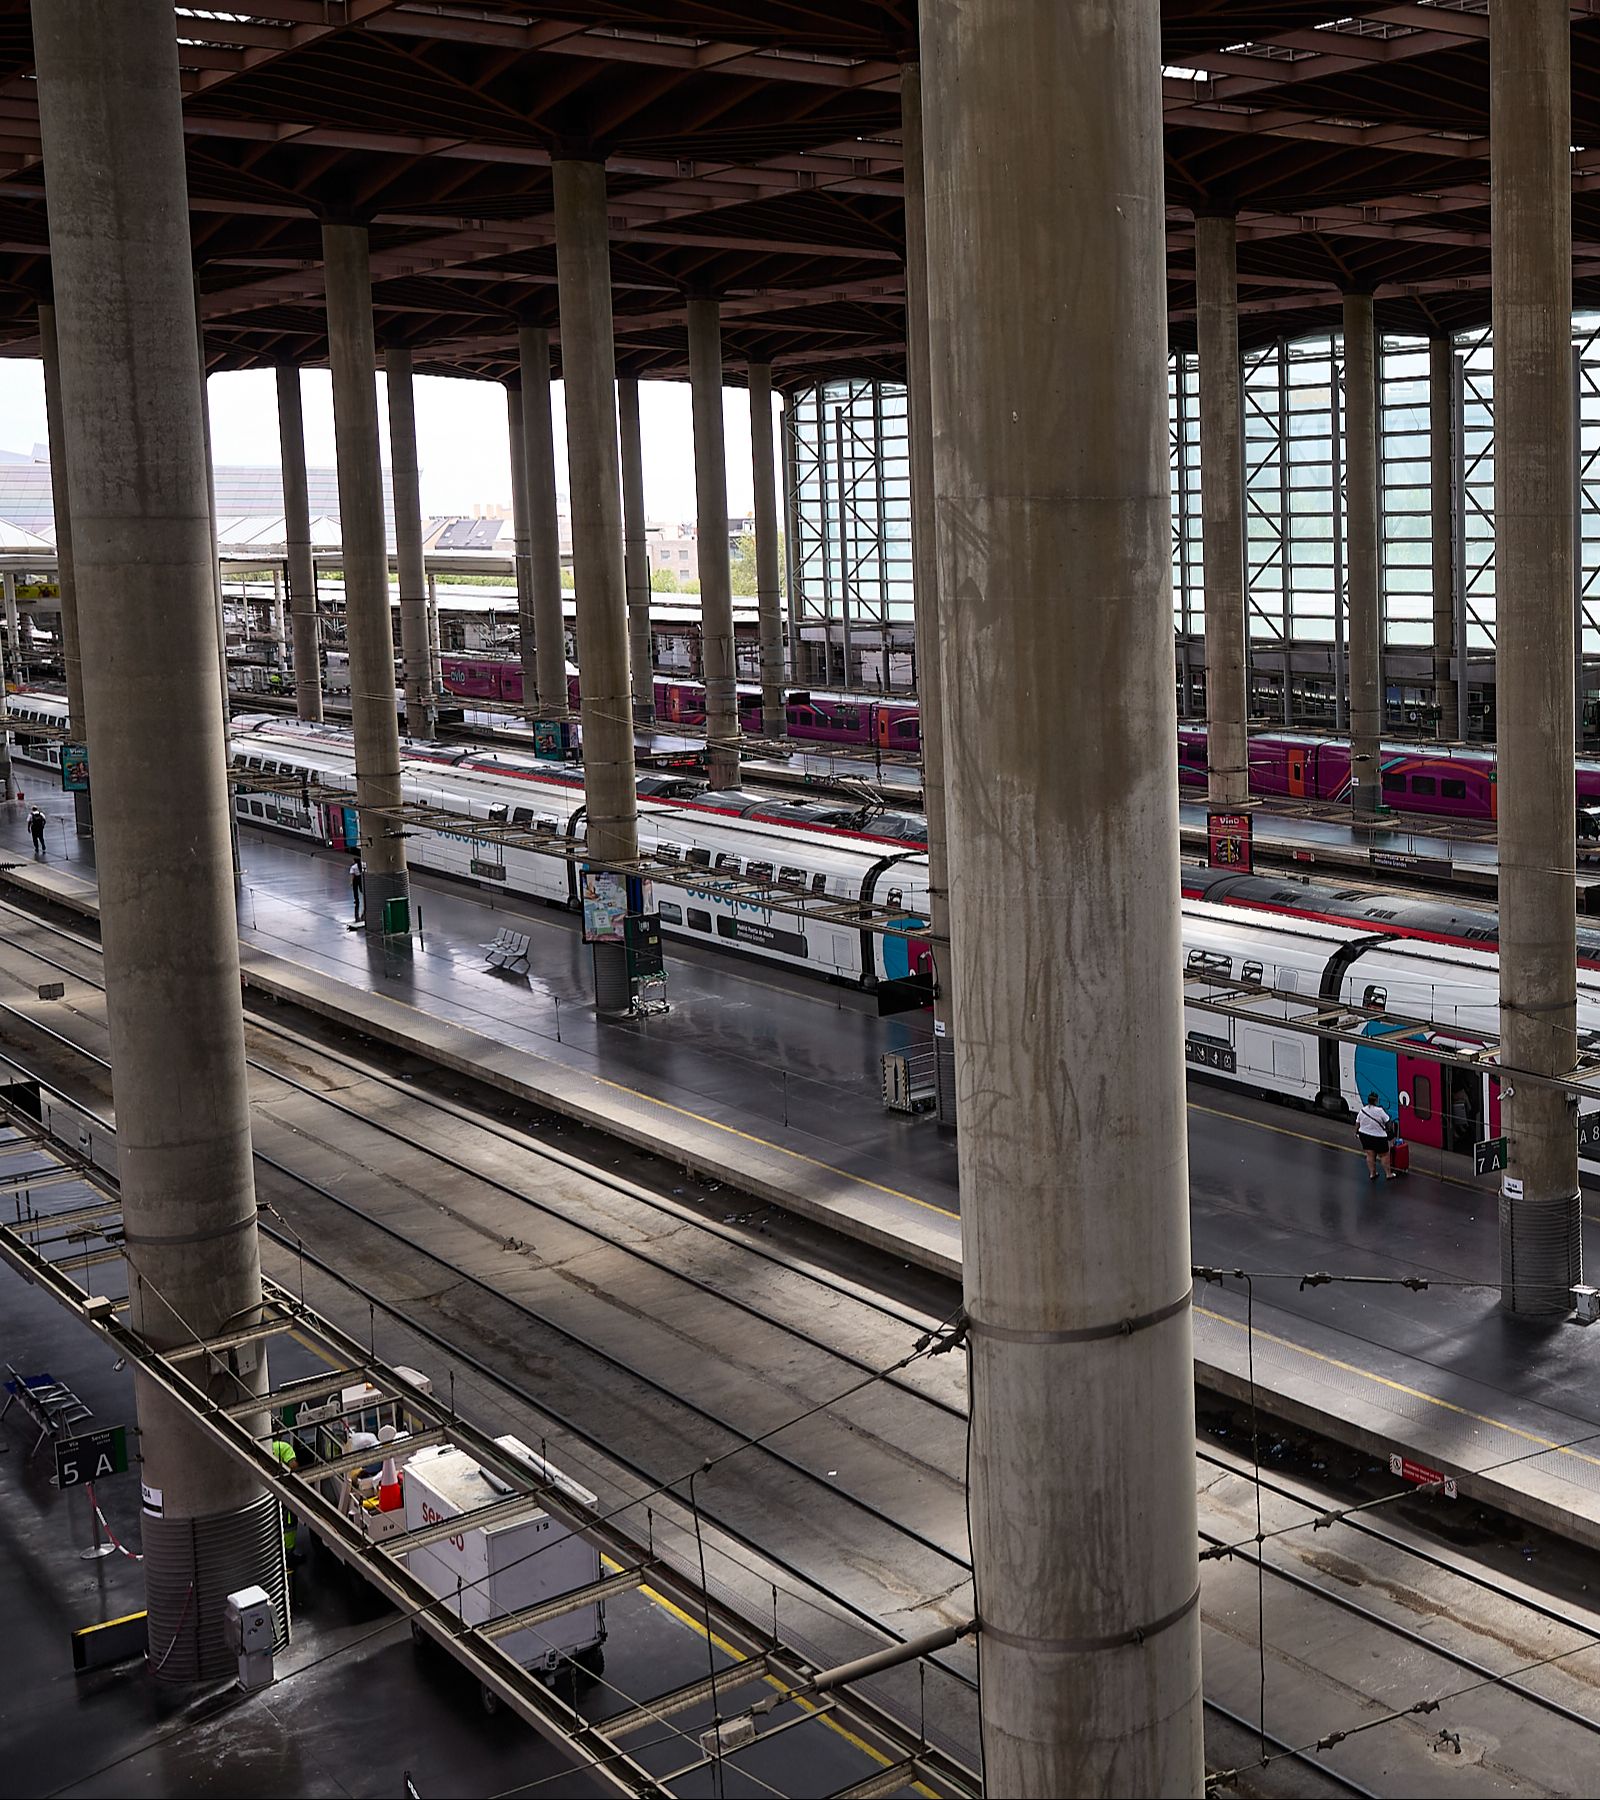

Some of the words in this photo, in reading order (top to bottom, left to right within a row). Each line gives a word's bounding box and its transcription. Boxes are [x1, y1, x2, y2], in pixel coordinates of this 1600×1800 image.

[1580, 1129, 1587, 1145] A
[1592, 1125, 1600, 1140] 8
[1477, 1158, 1485, 1173] 7
[1491, 1154, 1500, 1170] A
[91, 1433, 111, 1442] Sector
[63, 1461, 79, 1485] 5
[95, 1453, 113, 1477] A
